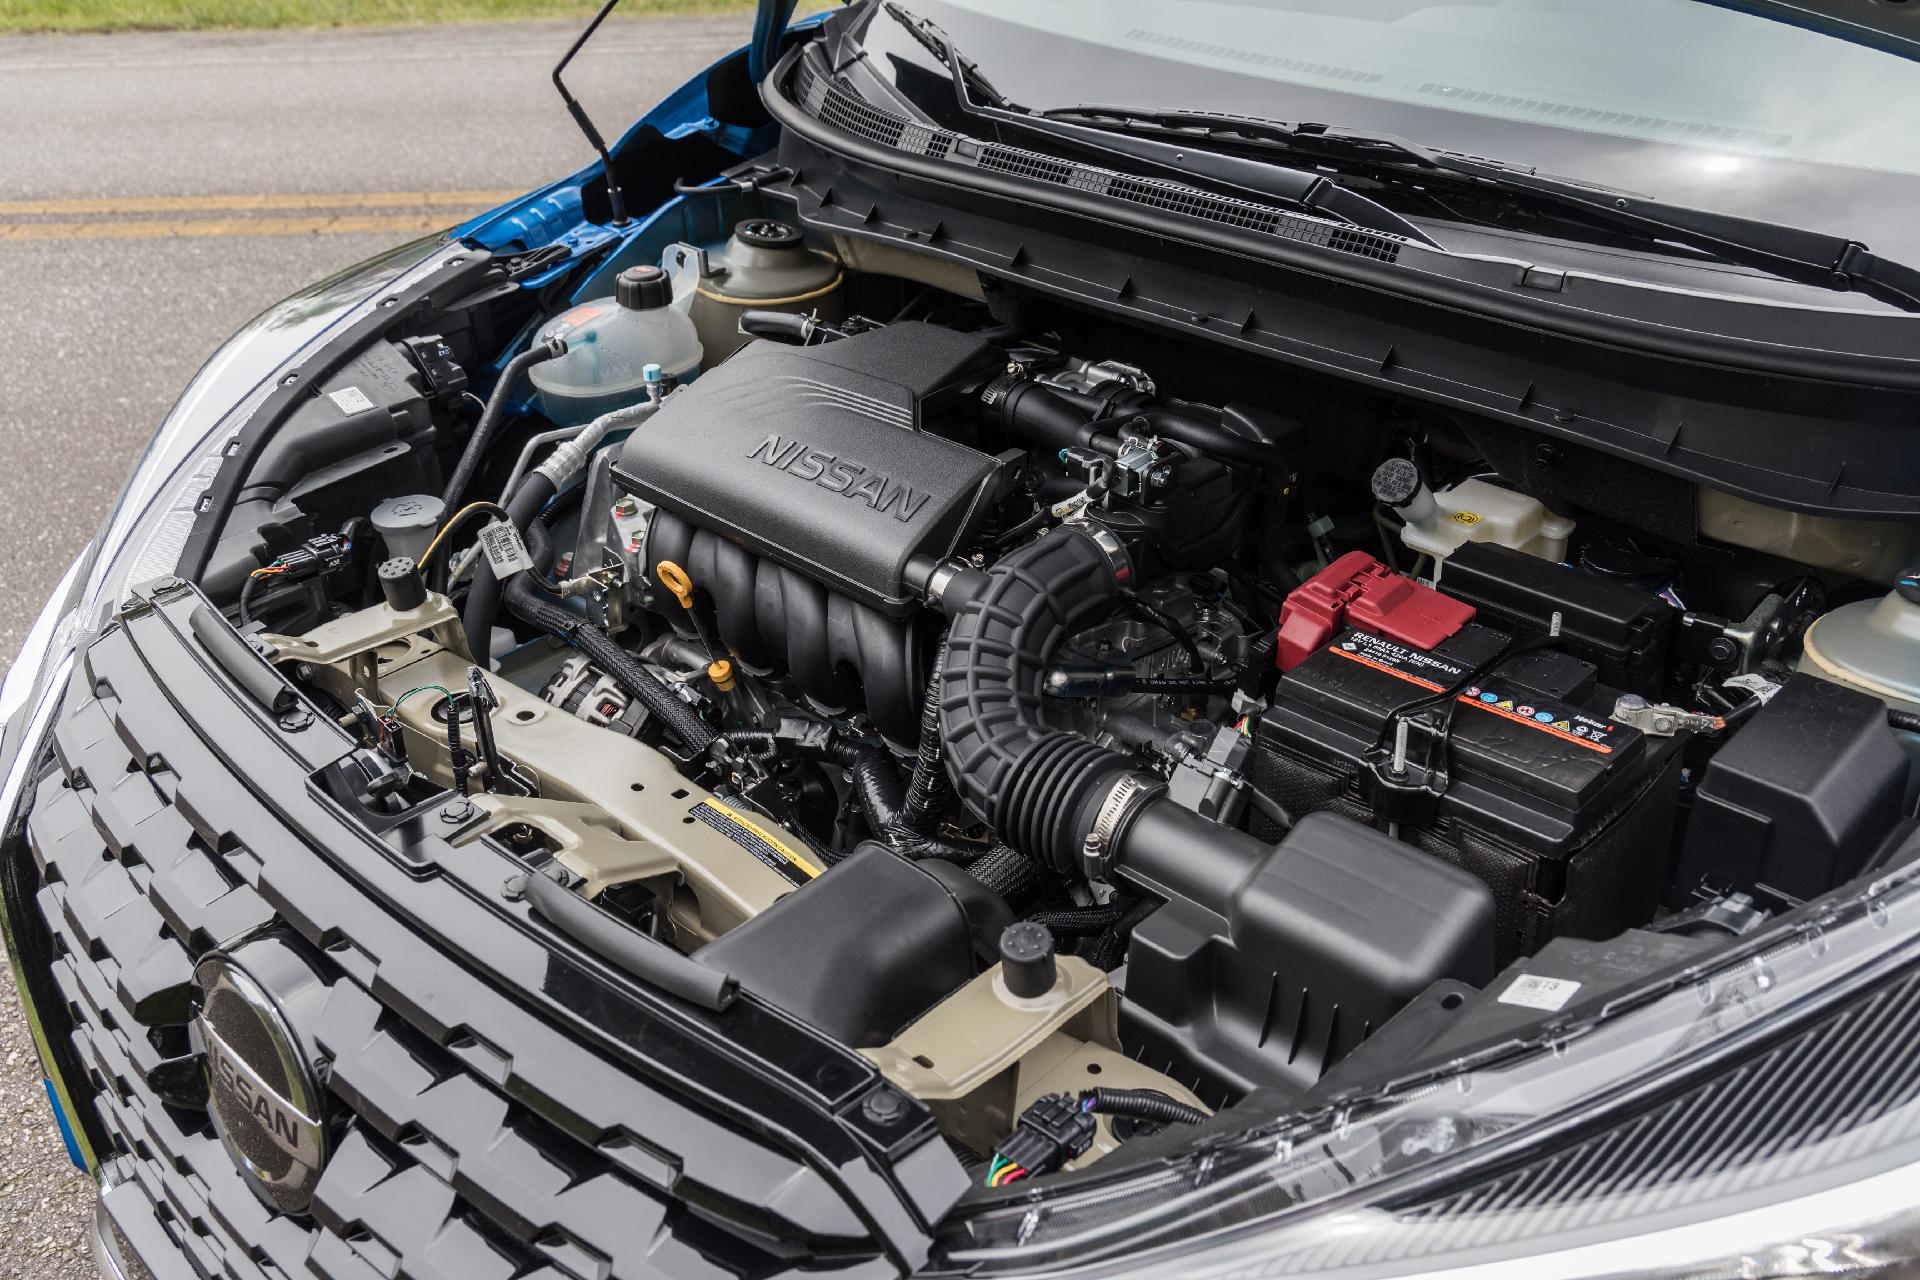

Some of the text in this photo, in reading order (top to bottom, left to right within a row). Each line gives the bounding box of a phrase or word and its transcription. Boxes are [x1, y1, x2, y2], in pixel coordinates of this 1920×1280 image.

[746, 434, 931, 522] NISSAN
[1353, 631, 1409, 654] RENAULT
[1408, 652, 1462, 675] NISSAN
